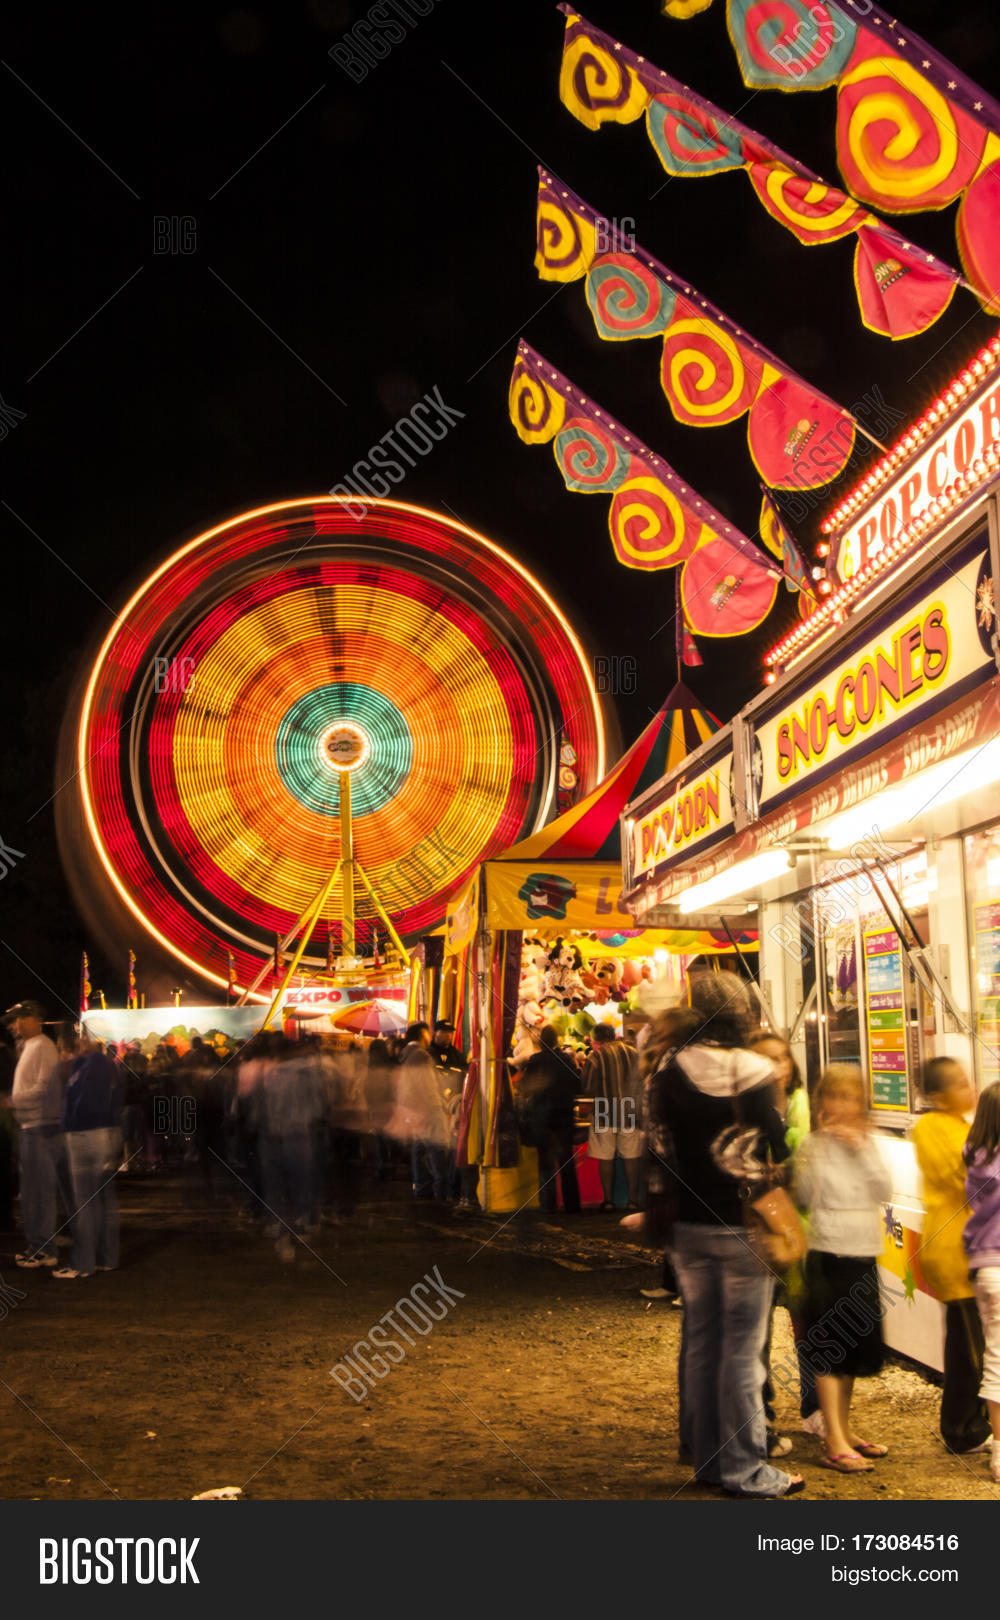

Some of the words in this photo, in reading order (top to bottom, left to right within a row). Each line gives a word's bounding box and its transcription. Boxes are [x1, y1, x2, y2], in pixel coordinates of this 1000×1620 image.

[777, 607, 949, 778] SNO-CONES
[641, 777, 720, 866] POPCORN
[286, 990, 342, 1004] EXPO
[347, 988, 407, 1001] WHEE
